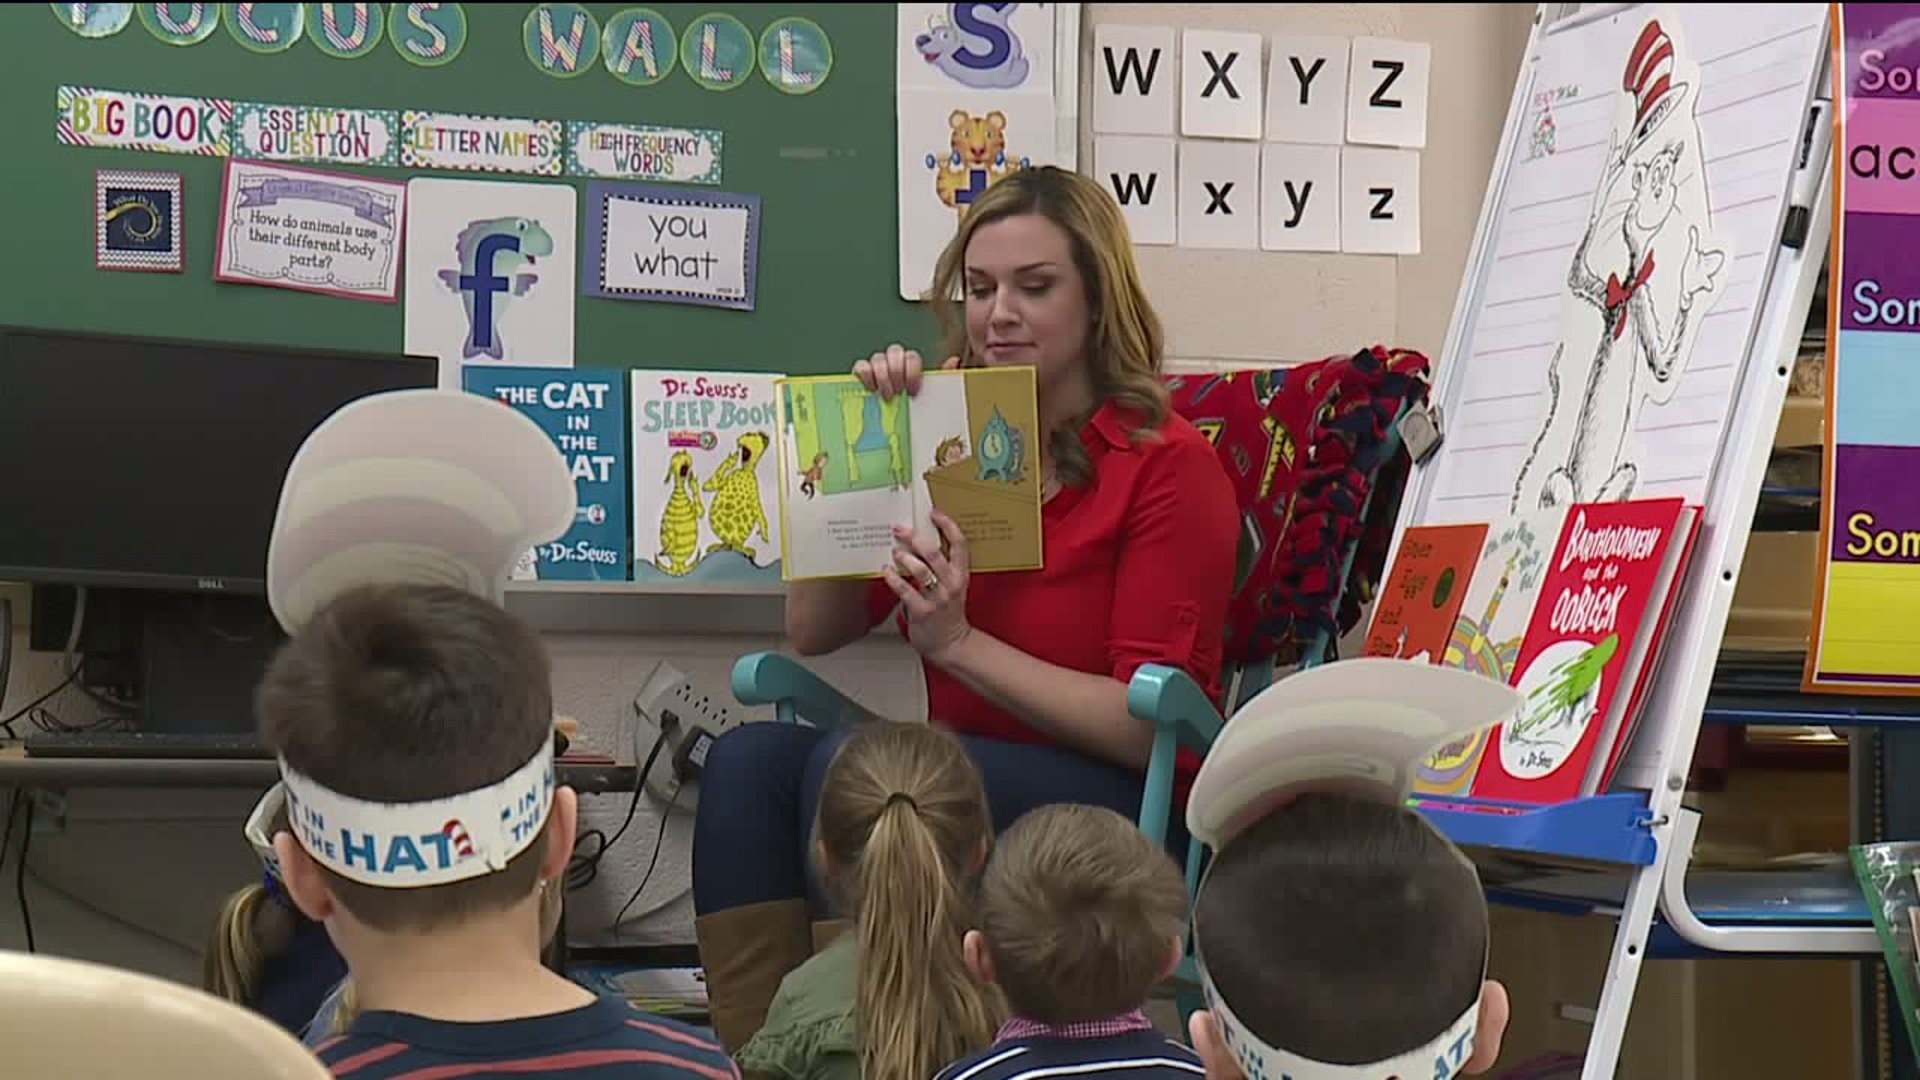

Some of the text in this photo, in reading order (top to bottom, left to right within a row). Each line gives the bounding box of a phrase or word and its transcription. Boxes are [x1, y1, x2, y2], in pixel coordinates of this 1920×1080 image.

[538, 8, 812, 84] WALL
[951, 3, 1011, 69] S
[1103, 47, 1161, 95] W
[1201, 50, 1241, 99] X
[1288, 57, 1326, 105] Y
[1369, 60, 1405, 109] Z
[1859, 49, 1920, 91] So
[72, 97, 218, 145] BIG BOOK
[258, 109, 370, 135] ESSENTIAL
[259, 132, 370, 158] QUESTION
[415, 126, 549, 157] LETTER NAMES
[589, 132, 700, 156] HIGH FREQUENCY
[613, 153, 674, 175] WORDS
[1110, 172, 1157, 205] w
[1203, 182, 1235, 215] x
[1283, 180, 1313, 228] y
[1368, 187, 1394, 220] z
[250, 210, 377, 239] How do animals use
[648, 213, 708, 244] you
[249, 228, 375, 261] their different body
[289, 254, 333, 270] parts?
[634, 248, 718, 281] what
[459, 233, 520, 348] f
[495, 382, 610, 409] THE CAT
[661, 376, 748, 400] Dr. Seuss's
[566, 415, 590, 430] IN
[642, 400, 716, 432] SLEEP
[559, 435, 598, 451] THE
[562, 454, 615, 482] AT
[550, 542, 576, 562] Dr.
[576, 540, 618, 565] Seuss
[1560, 509, 1662, 572] BARTHOLOMEW
[1550, 583, 1628, 635] OOBLECK
[340, 828, 458, 873] HAT
